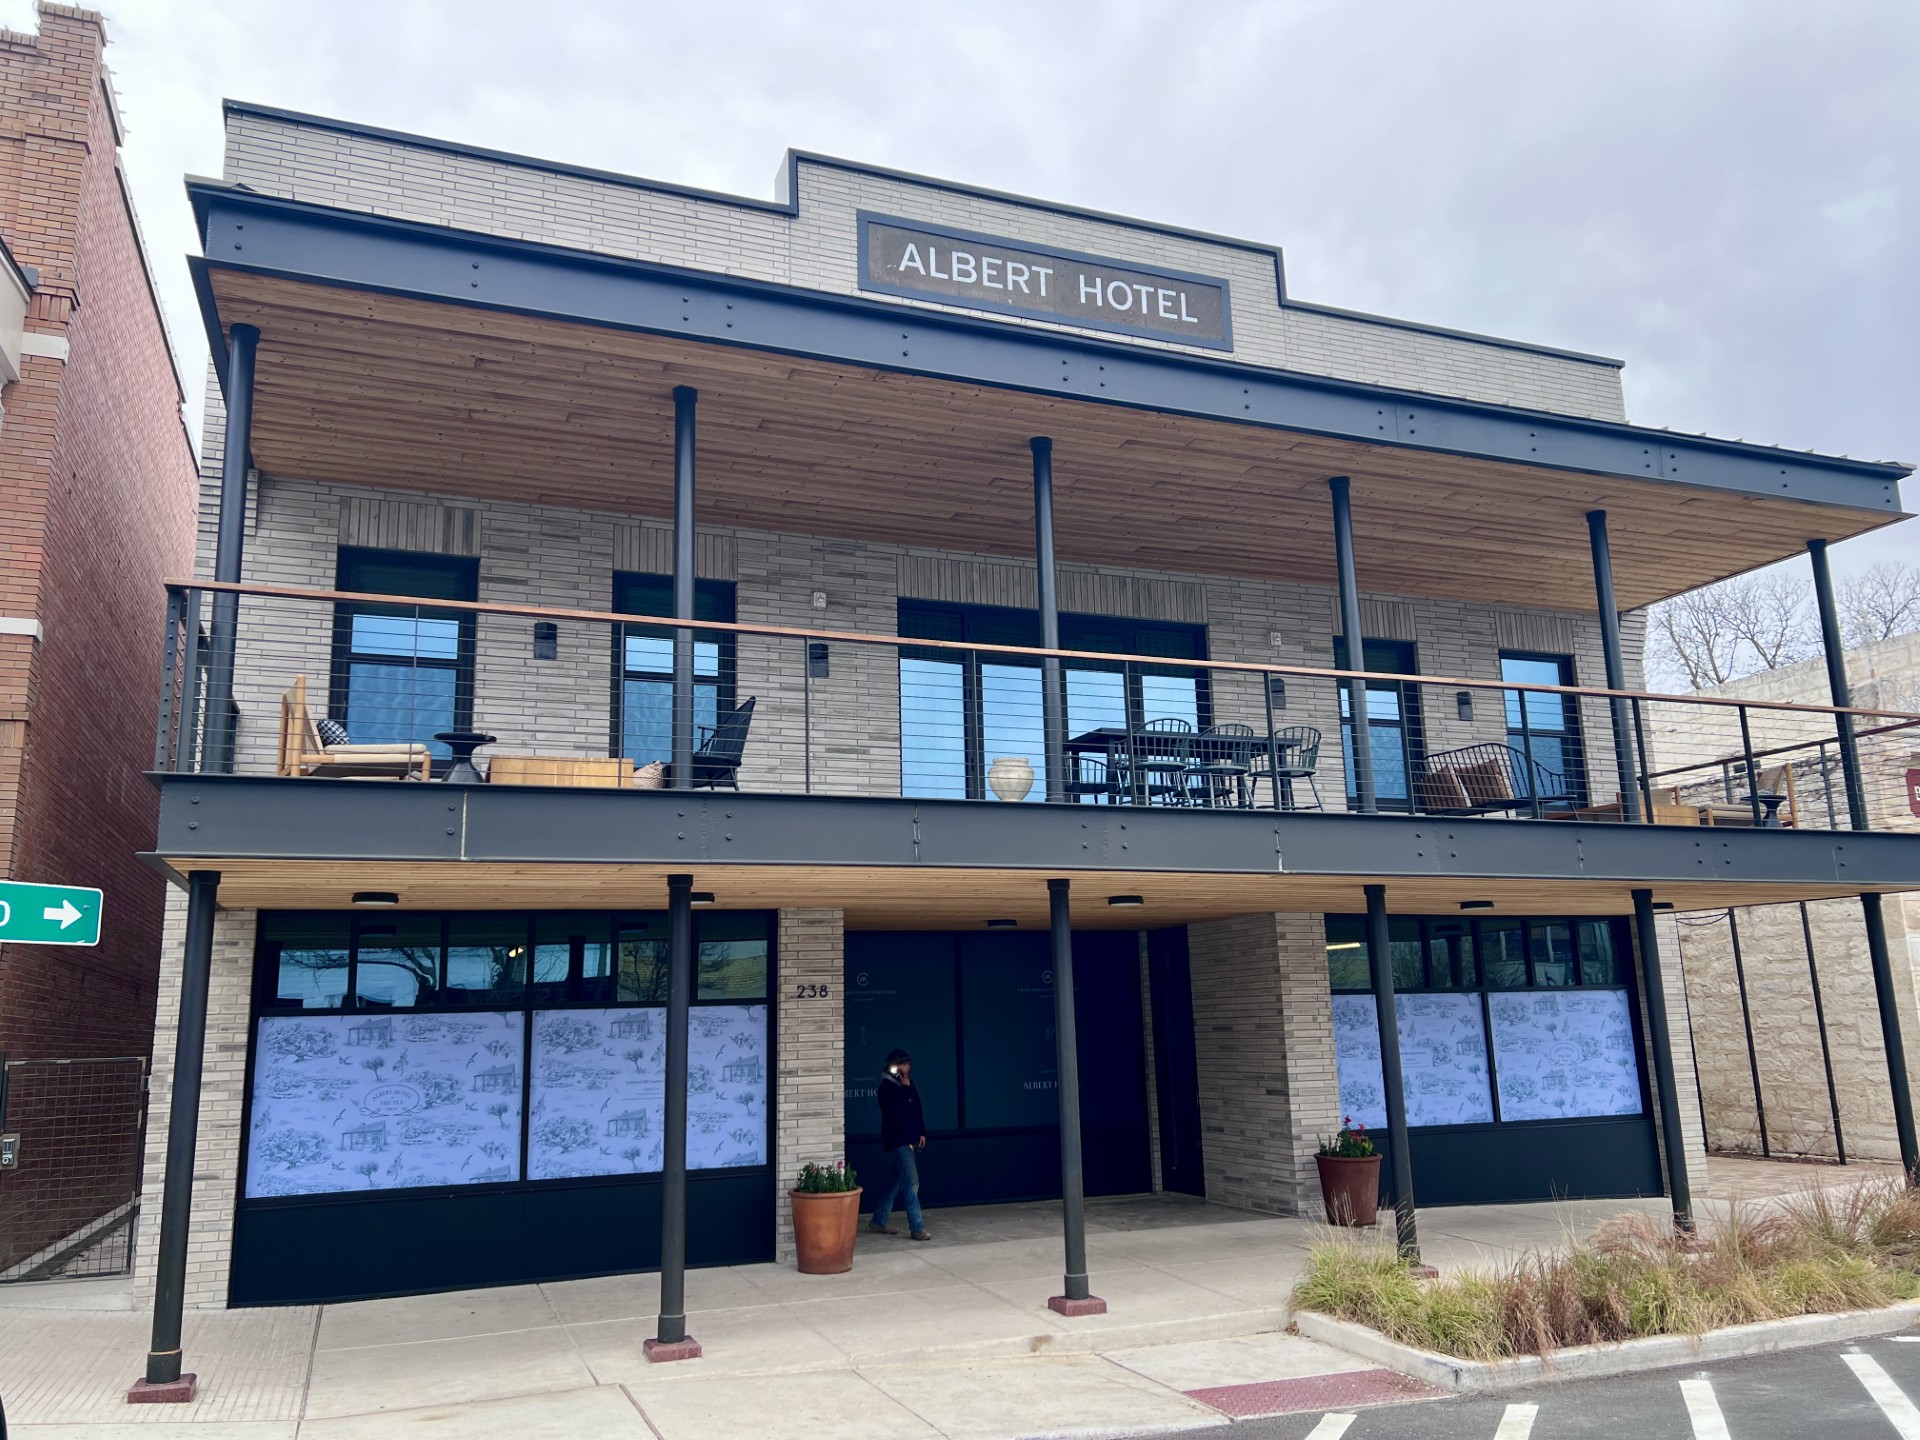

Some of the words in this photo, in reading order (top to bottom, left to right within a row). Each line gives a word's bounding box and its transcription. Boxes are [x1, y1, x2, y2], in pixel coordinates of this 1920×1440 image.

[899, 243, 1053, 297] ALBERT
[1079, 274, 1198, 323] HOTEL
[796, 984, 828, 998] 238
[1023, 1081, 1052, 1090] ALBERT
[845, 1088, 865, 1098] BERT
